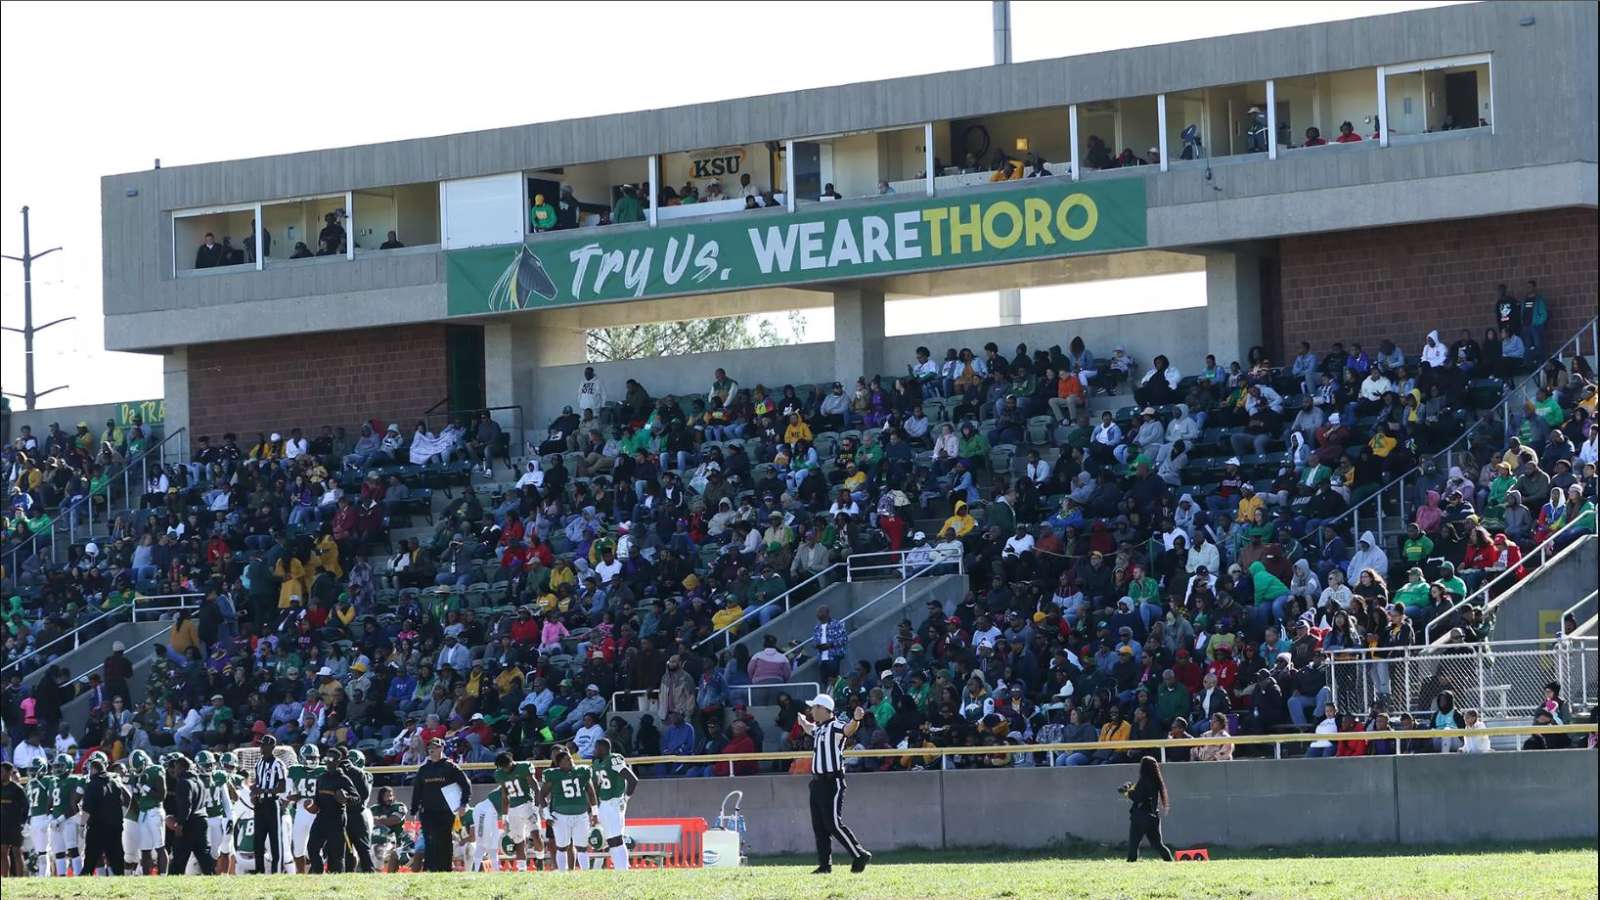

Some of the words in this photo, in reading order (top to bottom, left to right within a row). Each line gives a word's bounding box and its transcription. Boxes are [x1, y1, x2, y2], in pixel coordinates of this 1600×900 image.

[693, 155, 741, 178] KSU
[569, 242, 655, 300] Try
[662, 233, 731, 284] Us.
[298, 778, 317, 797] 43
[504, 779, 525, 799] 21
[561, 777, 582, 799] 51
